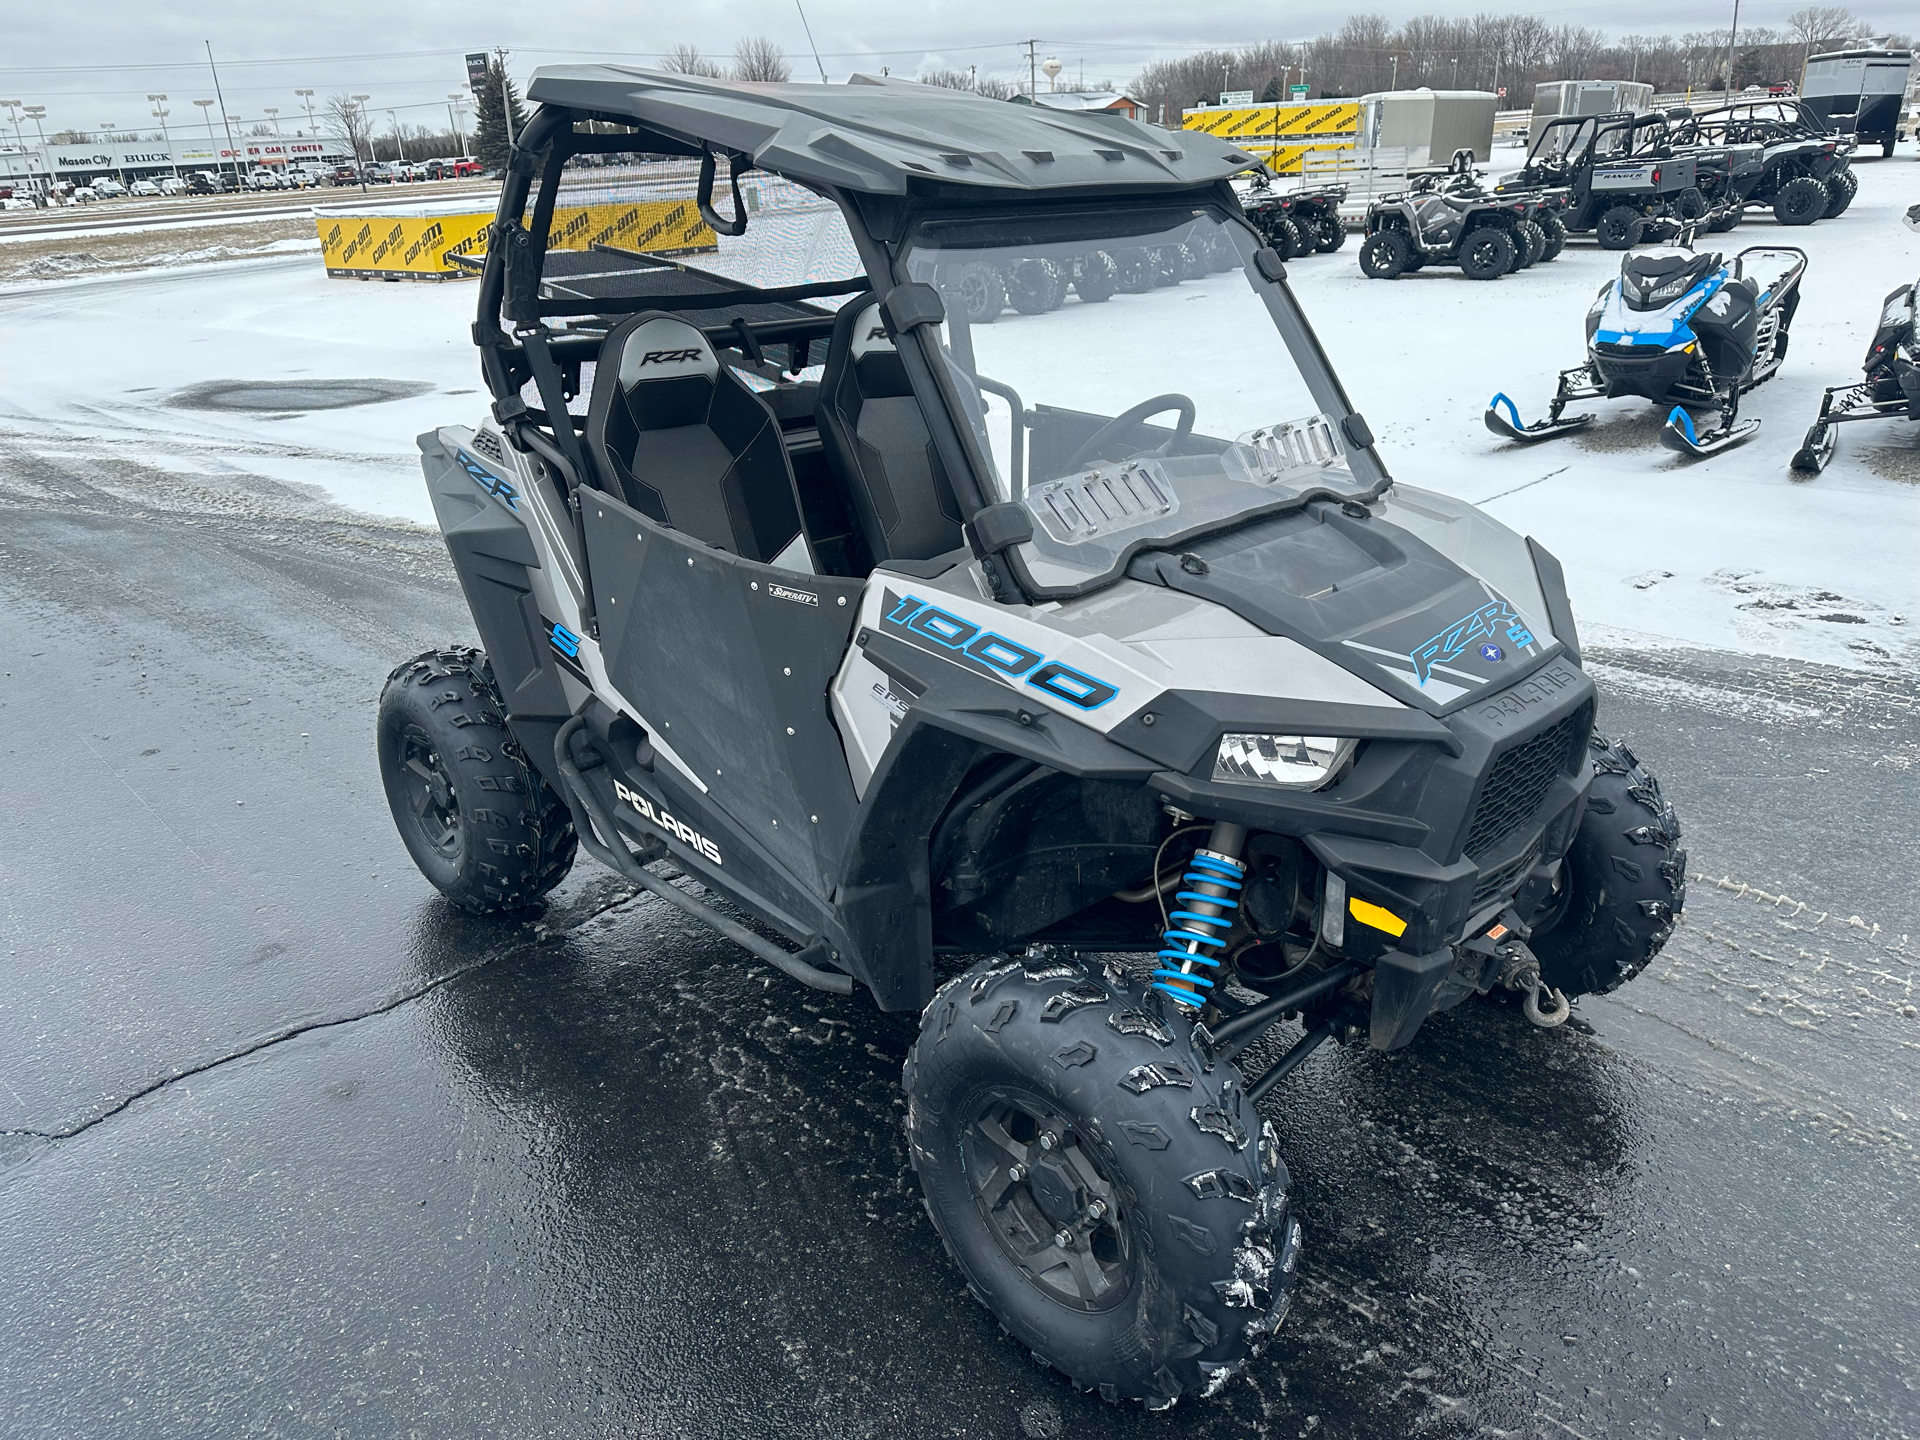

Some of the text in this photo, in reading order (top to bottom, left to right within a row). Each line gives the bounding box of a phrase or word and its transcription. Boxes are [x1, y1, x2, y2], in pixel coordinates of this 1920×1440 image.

[58, 153, 112, 167] Mason City
[123, 152, 171, 163] BUICK
[220, 149, 241, 158] GMC
[265, 146, 286, 154] CARE
[291, 144, 323, 153] CENTER
[343, 222, 371, 264] can-am
[372, 222, 403, 265] can-am
[404, 222, 443, 266] can-am
[637, 204, 686, 247] can-am
[639, 348, 703, 368] RZR
[453, 446, 522, 513] RZR
[551, 621, 580, 657] S
[885, 594, 1121, 711] 1000
[1409, 600, 1534, 688] RZR S
[872, 682, 911, 713] EPS
[1478, 666, 1578, 727] POLARIS
[613, 779, 723, 866] POLARIS
